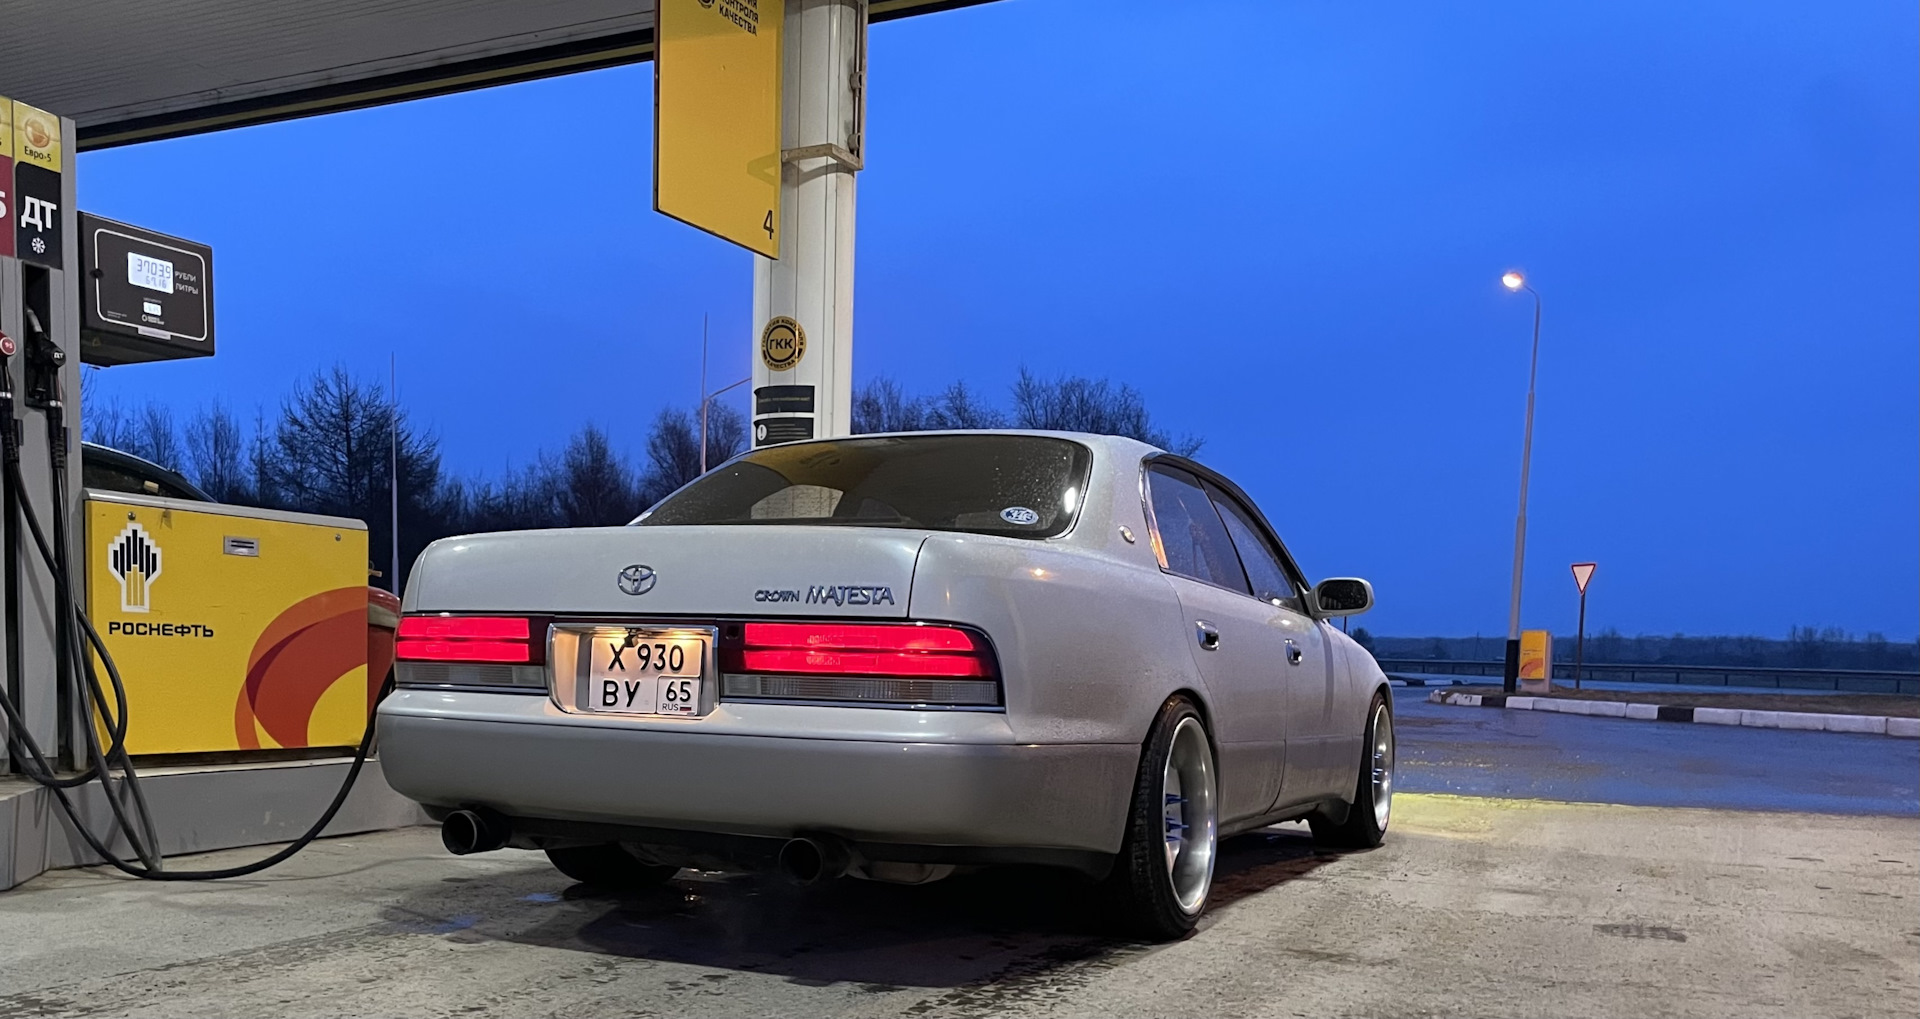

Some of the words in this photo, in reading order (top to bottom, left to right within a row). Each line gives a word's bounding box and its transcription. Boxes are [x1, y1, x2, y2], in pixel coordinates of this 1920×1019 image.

[719, 4, 757, 36] КАЧЕСТВА
[721, 0, 758, 24] ОНТРОЛЯ
[24, 146, 52, 162] Евро-5
[20, 195, 57, 233] ДТ
[763, 210, 774, 240] 4
[175, 271, 197, 283] РУБЛИ
[175, 283, 199, 295] ЛИТРЫ
[769, 338, 793, 350] ГКК
[754, 589, 799, 602] CROWN
[805, 584, 895, 607] MAJESTA
[108, 621, 214, 638] РОСНЕФТЬ
[637, 643, 684, 671] 930
[666, 681, 691, 702] 65
[662, 703, 679, 711] RUS
